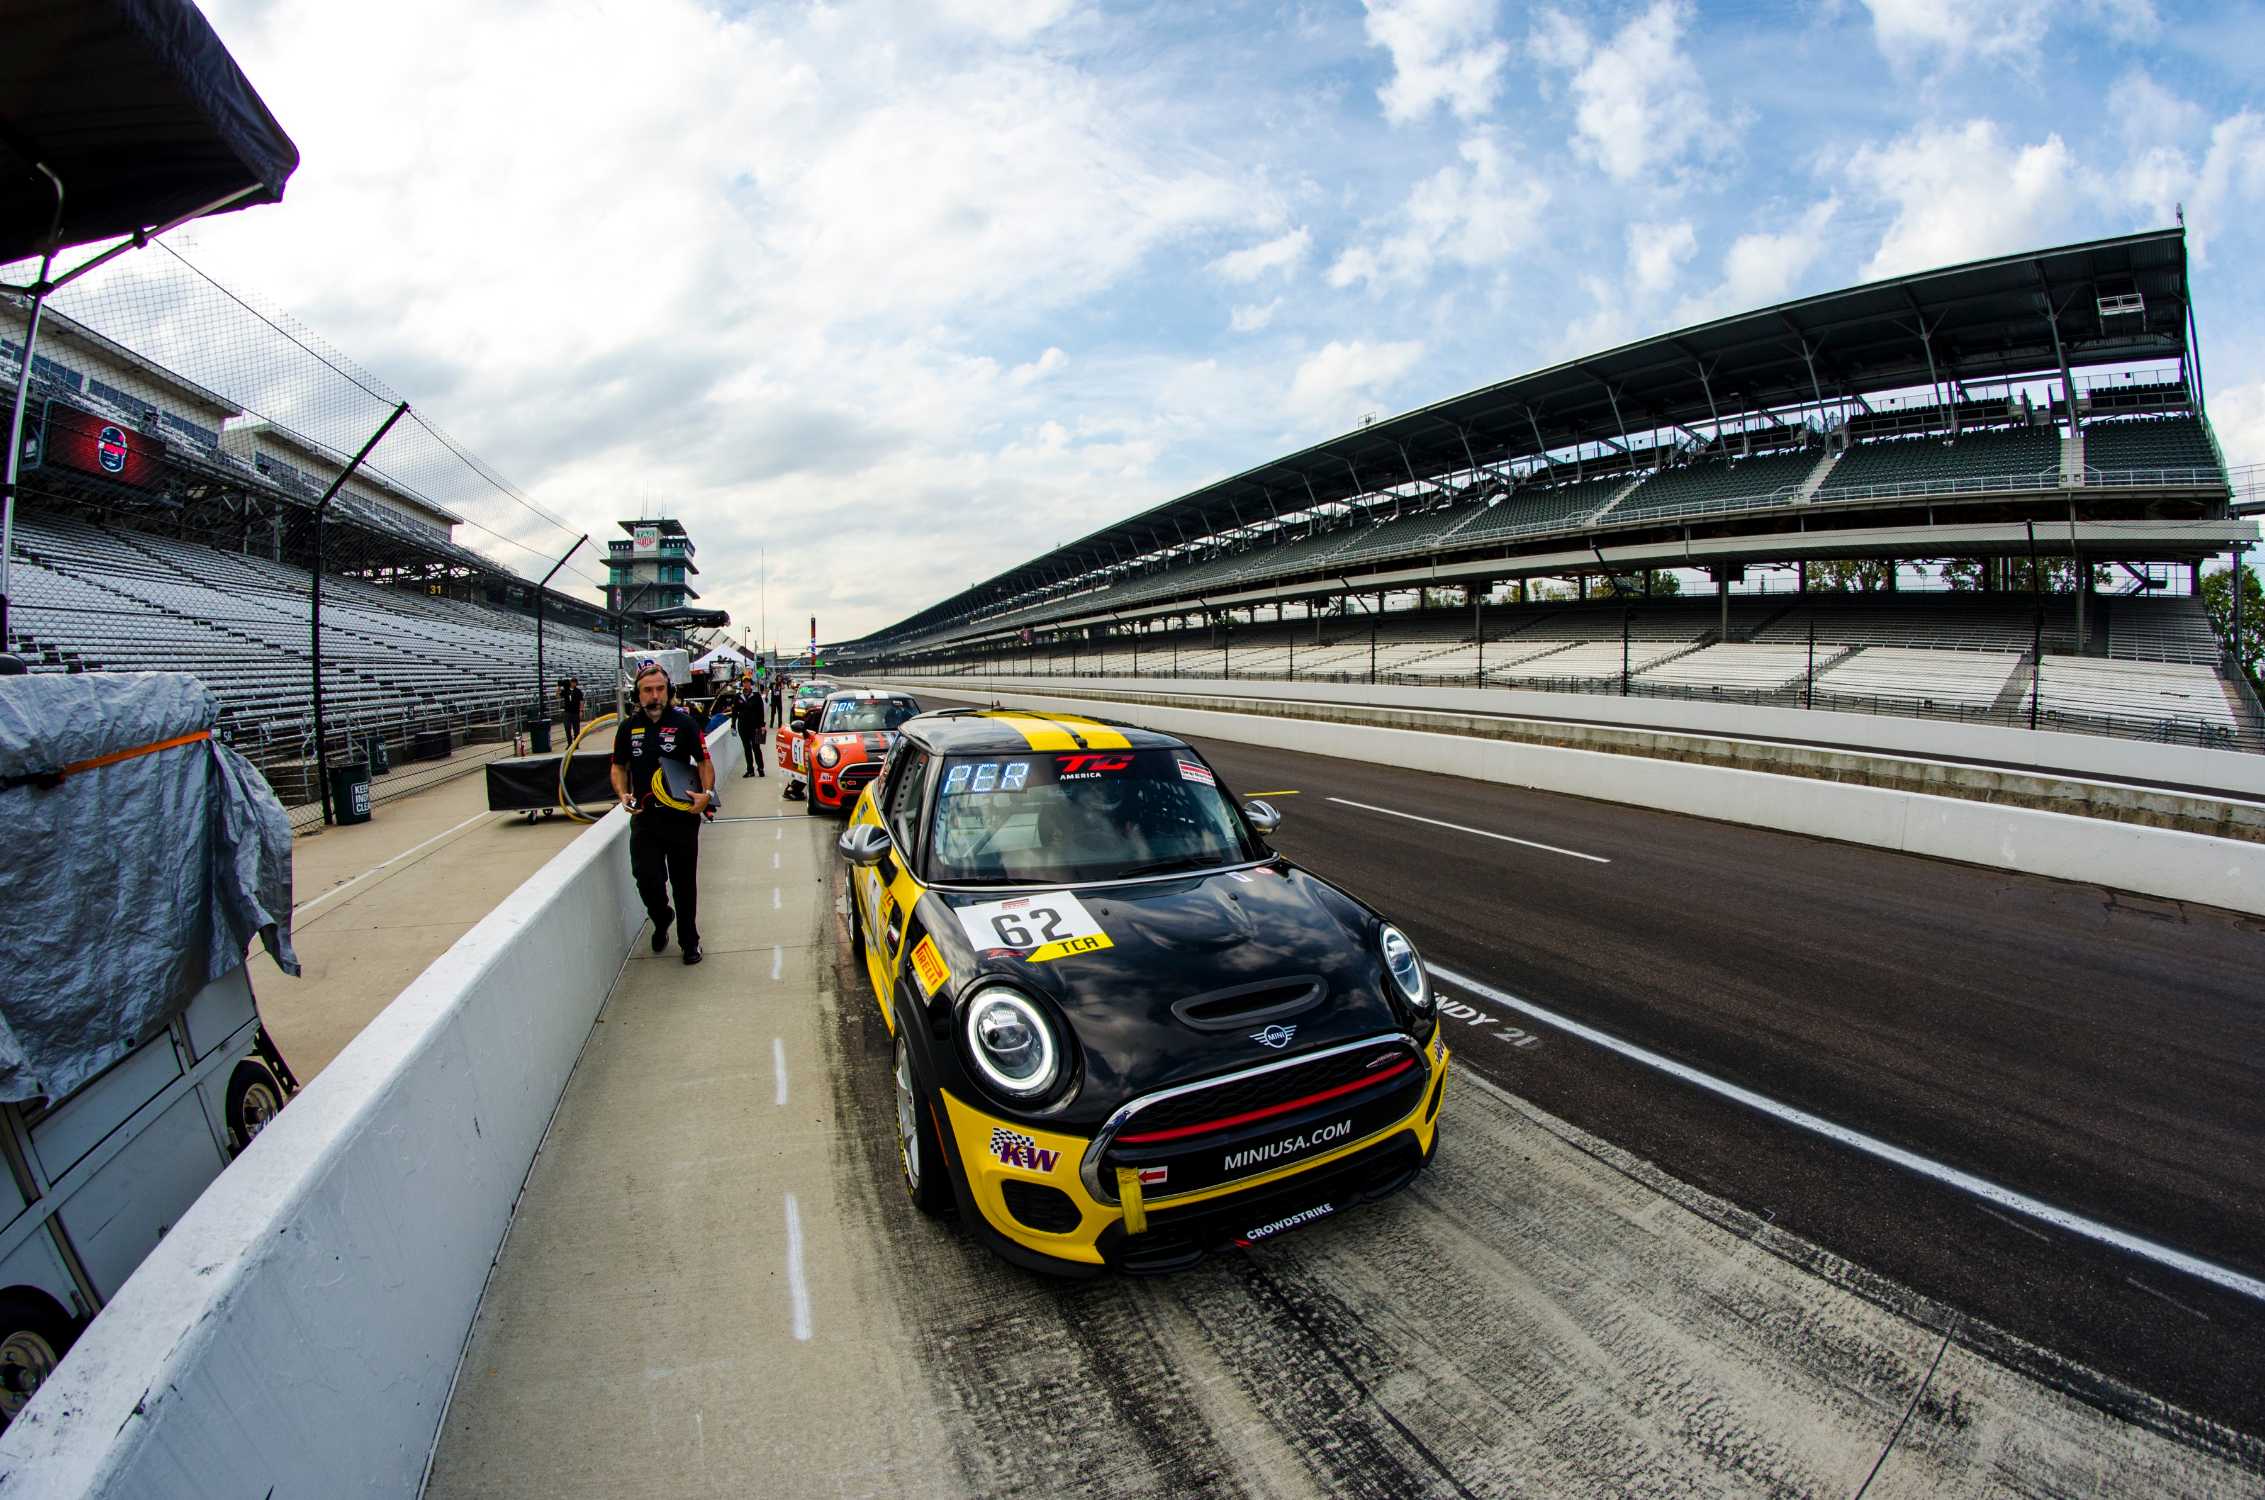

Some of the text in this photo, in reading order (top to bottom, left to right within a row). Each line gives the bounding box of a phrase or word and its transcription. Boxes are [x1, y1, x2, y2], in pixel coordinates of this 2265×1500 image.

[944, 763, 1029, 794] PER
[1060, 772, 1102, 781] AMERICA
[991, 908, 1074, 947] 62
[1057, 937, 1099, 954] TCA
[915, 941, 944, 986] PIRELLI
[1434, 991, 1499, 1026] NDY
[1267, 1031, 1286, 1041] MINI
[1000, 1141, 1061, 1173] KW
[1224, 1119, 1352, 1171] MINIUSA.COM
[1246, 1202, 1334, 1240] CROWDSTRIKE
